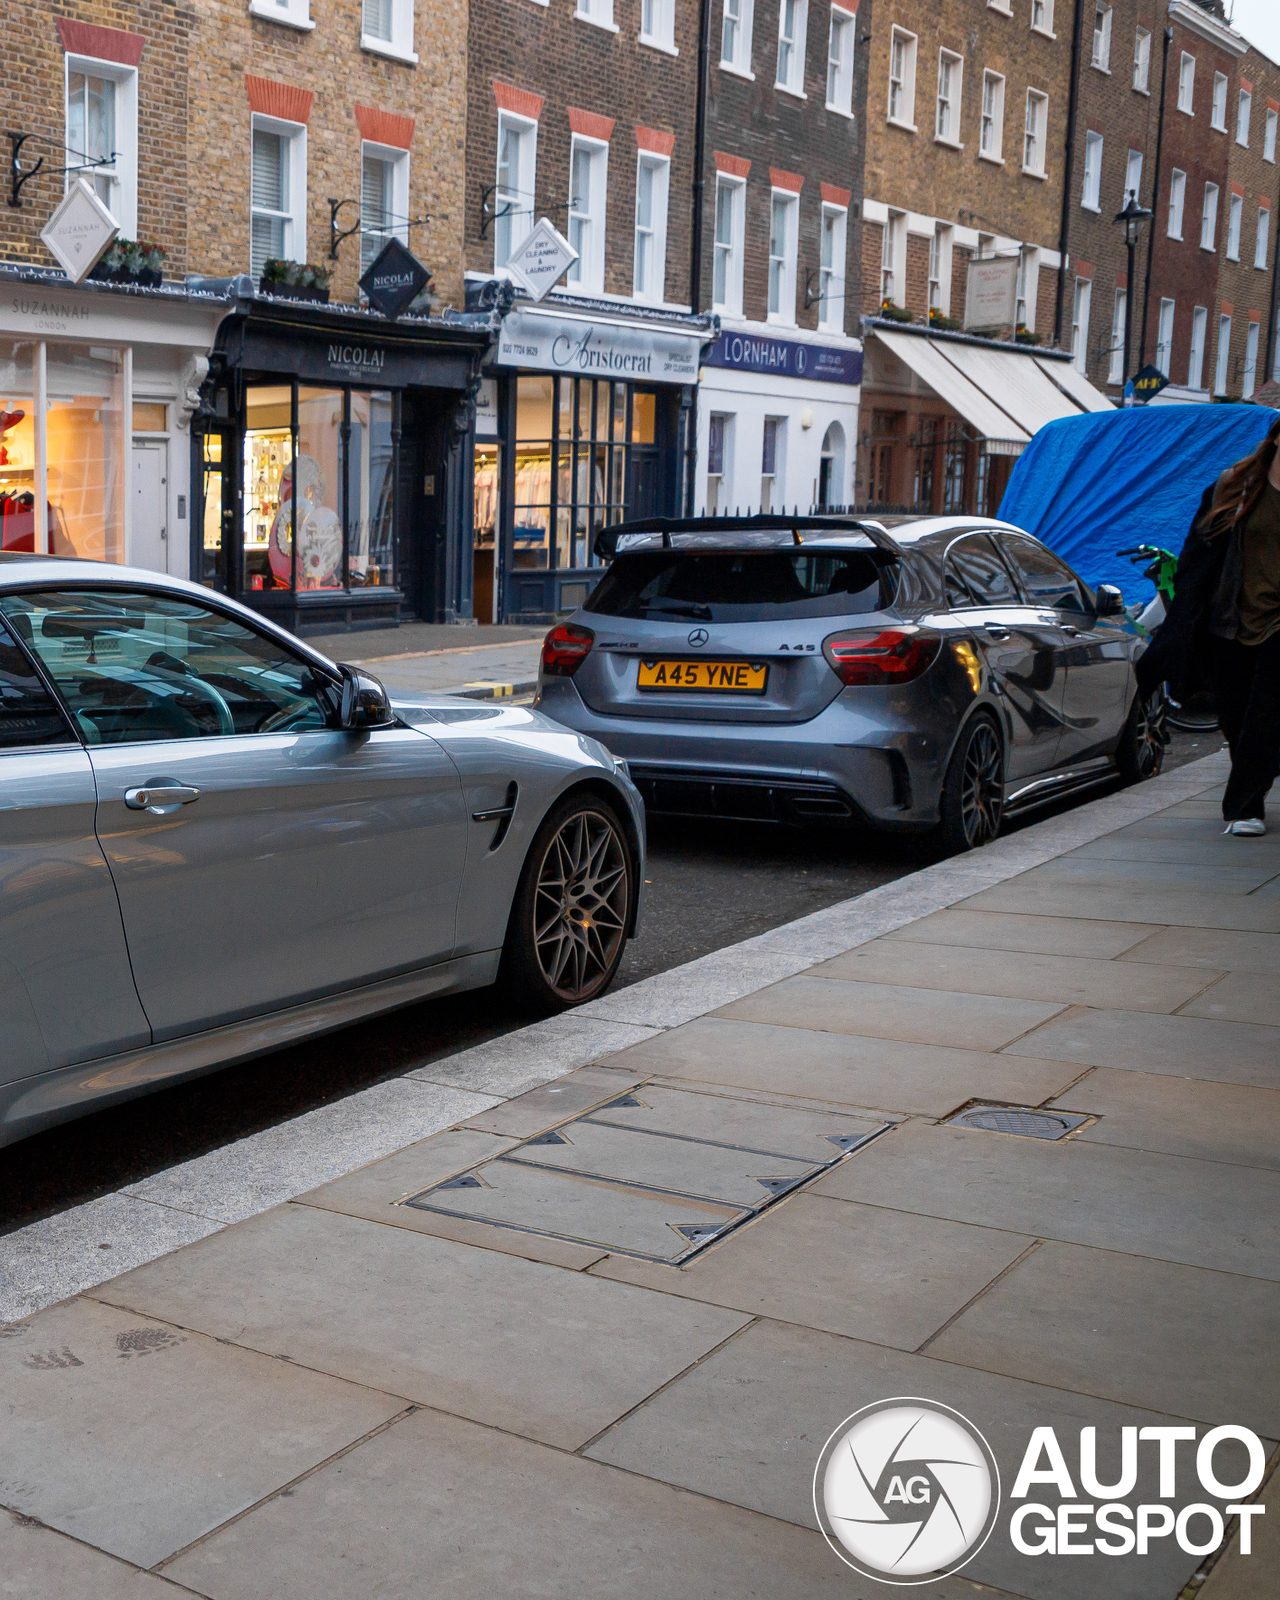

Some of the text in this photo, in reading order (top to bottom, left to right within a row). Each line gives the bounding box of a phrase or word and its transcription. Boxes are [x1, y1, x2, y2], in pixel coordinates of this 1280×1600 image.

[58, 224, 100, 236] SUZANNAH
[535, 241, 549, 249] DRY
[525, 248, 559, 258] CLEANING
[525, 265, 557, 275] LAUNDRY
[12, 299, 90, 320] SUZANNAH
[35, 320, 67, 331] LONDON
[552, 326, 651, 373] Aristocrat
[724, 337, 787, 368] LORNHAM
[654, 664, 750, 687] A45 YNE
